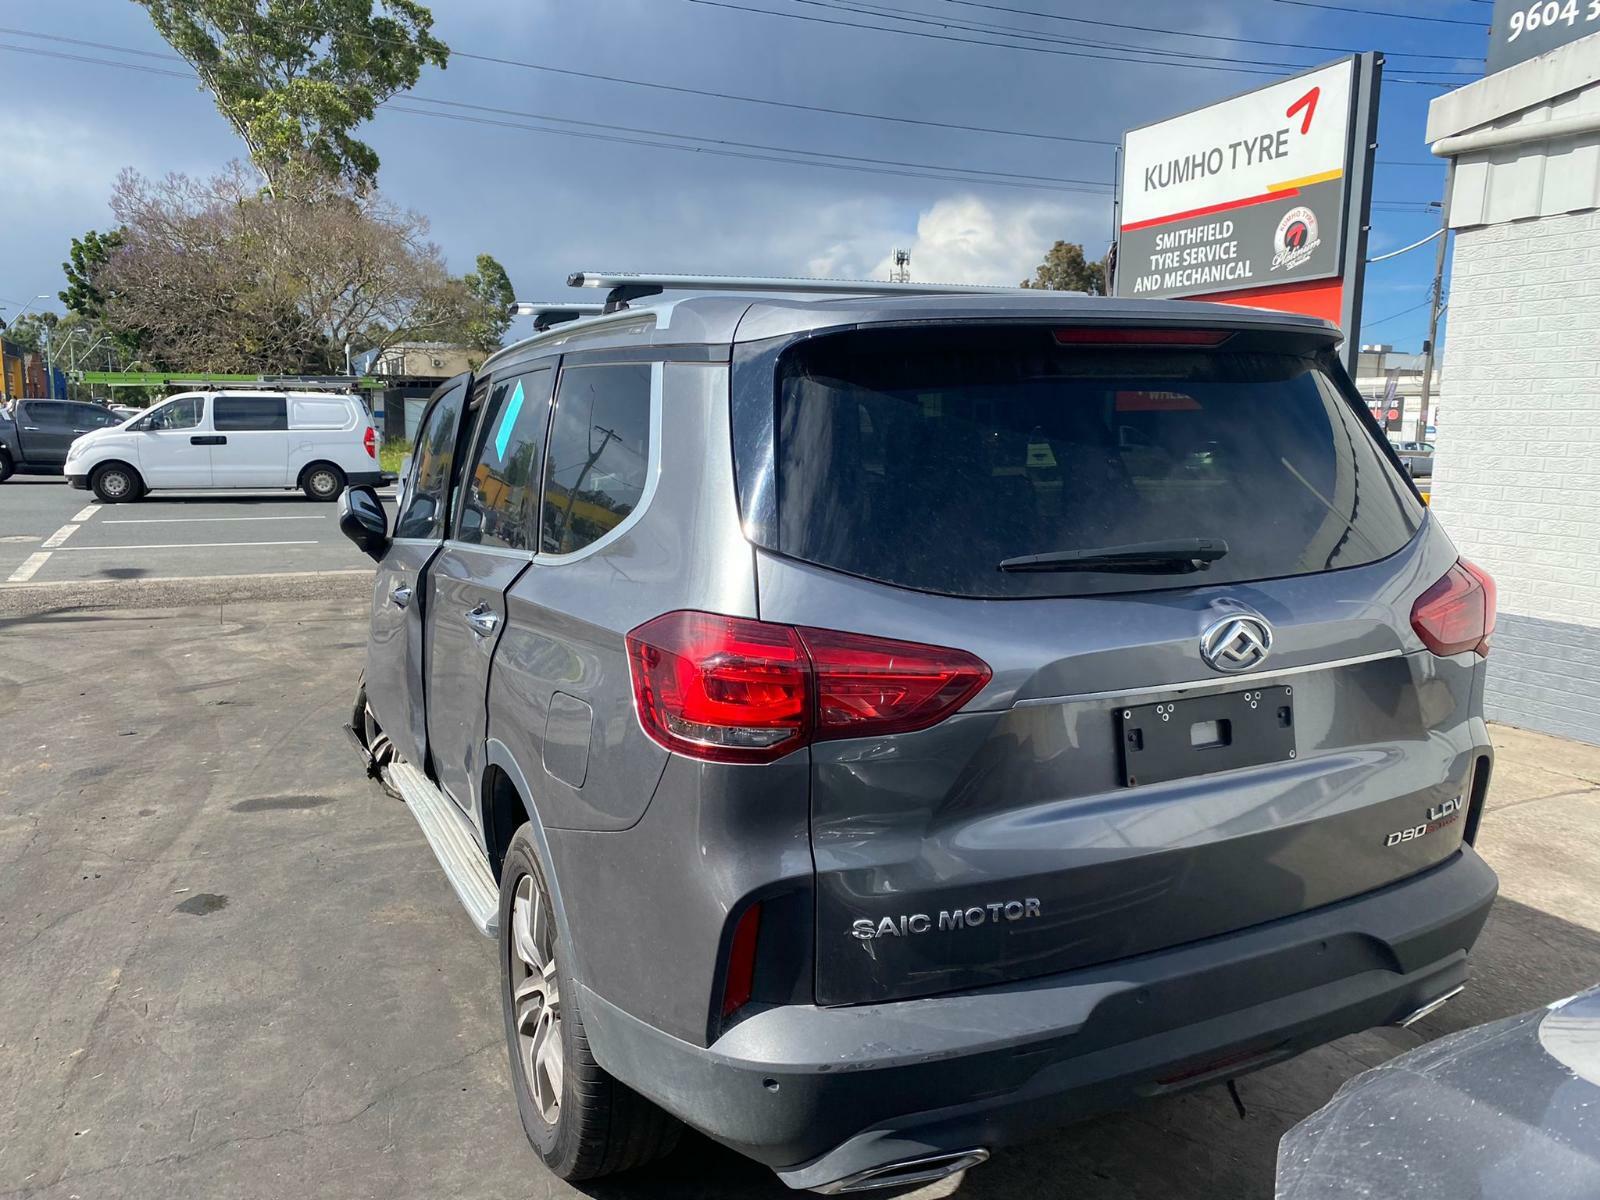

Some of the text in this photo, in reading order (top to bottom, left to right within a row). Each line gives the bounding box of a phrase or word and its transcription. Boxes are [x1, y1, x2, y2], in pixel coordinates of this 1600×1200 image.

[1507, 0, 1580, 42] 9604
[1144, 128, 1291, 192] KUMHO TYRE
[1155, 220, 1234, 251] SMITHFIELD
[1150, 240, 1238, 271] TYRE SERVICE
[1134, 260, 1253, 293] AND MECHANICAL
[1429, 795, 1464, 820] LDV
[1386, 823, 1427, 847] D90
[851, 898, 1041, 940] SAIC MOTOR
